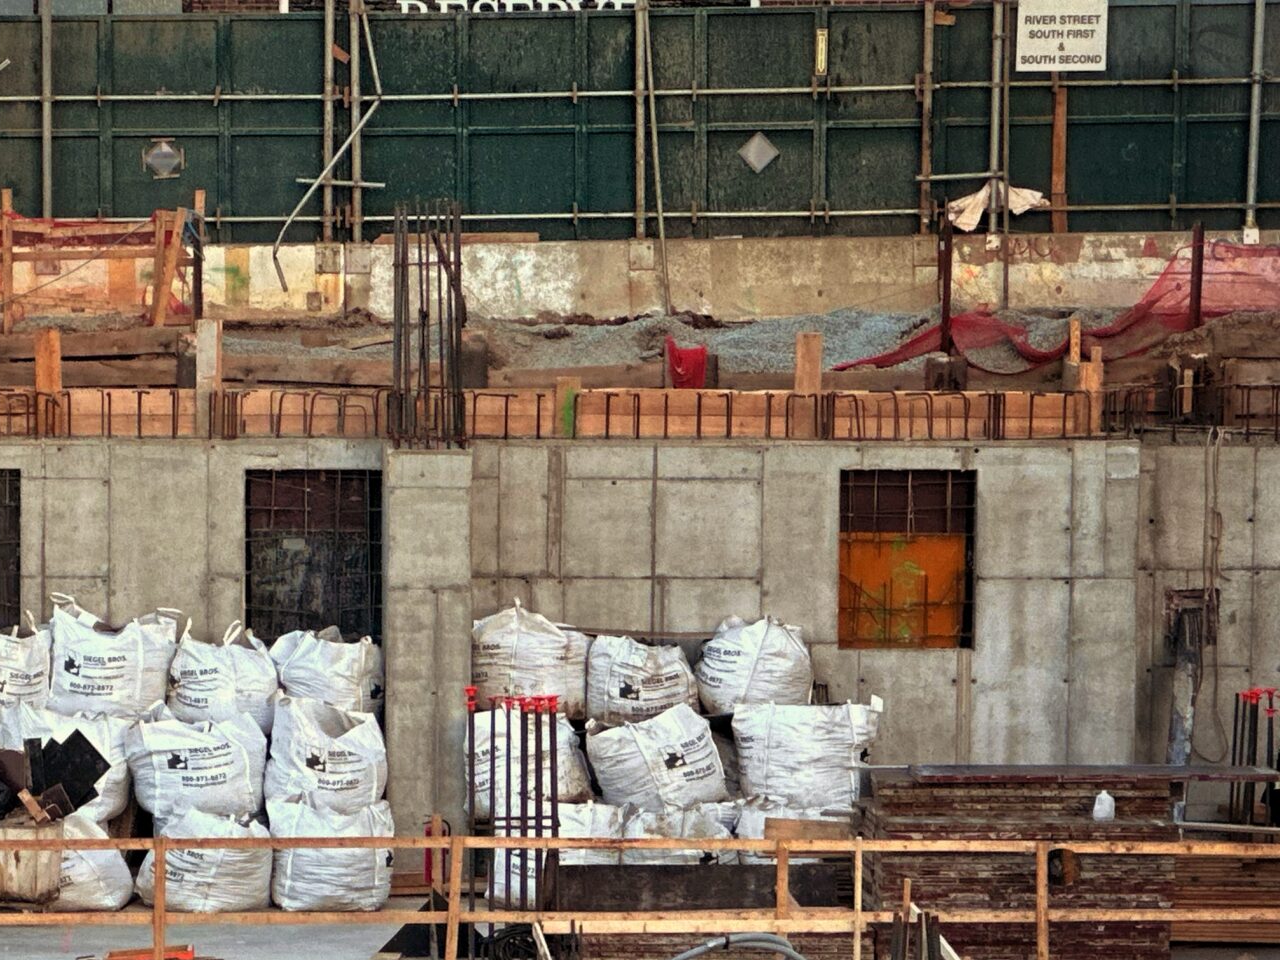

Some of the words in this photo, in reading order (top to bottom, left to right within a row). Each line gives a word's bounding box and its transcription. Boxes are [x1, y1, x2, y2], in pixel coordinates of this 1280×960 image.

[1024, 14, 1057, 25] RIVER
[1059, 14, 1102, 25] STREET
[1028, 29, 1064, 39] SOUTH
[1066, 29, 1096, 39] FIRST
[1057, 42, 1065, 51] &
[1020, 54, 1056, 64] SOUTH
[1058, 54, 1102, 64] SECOND
